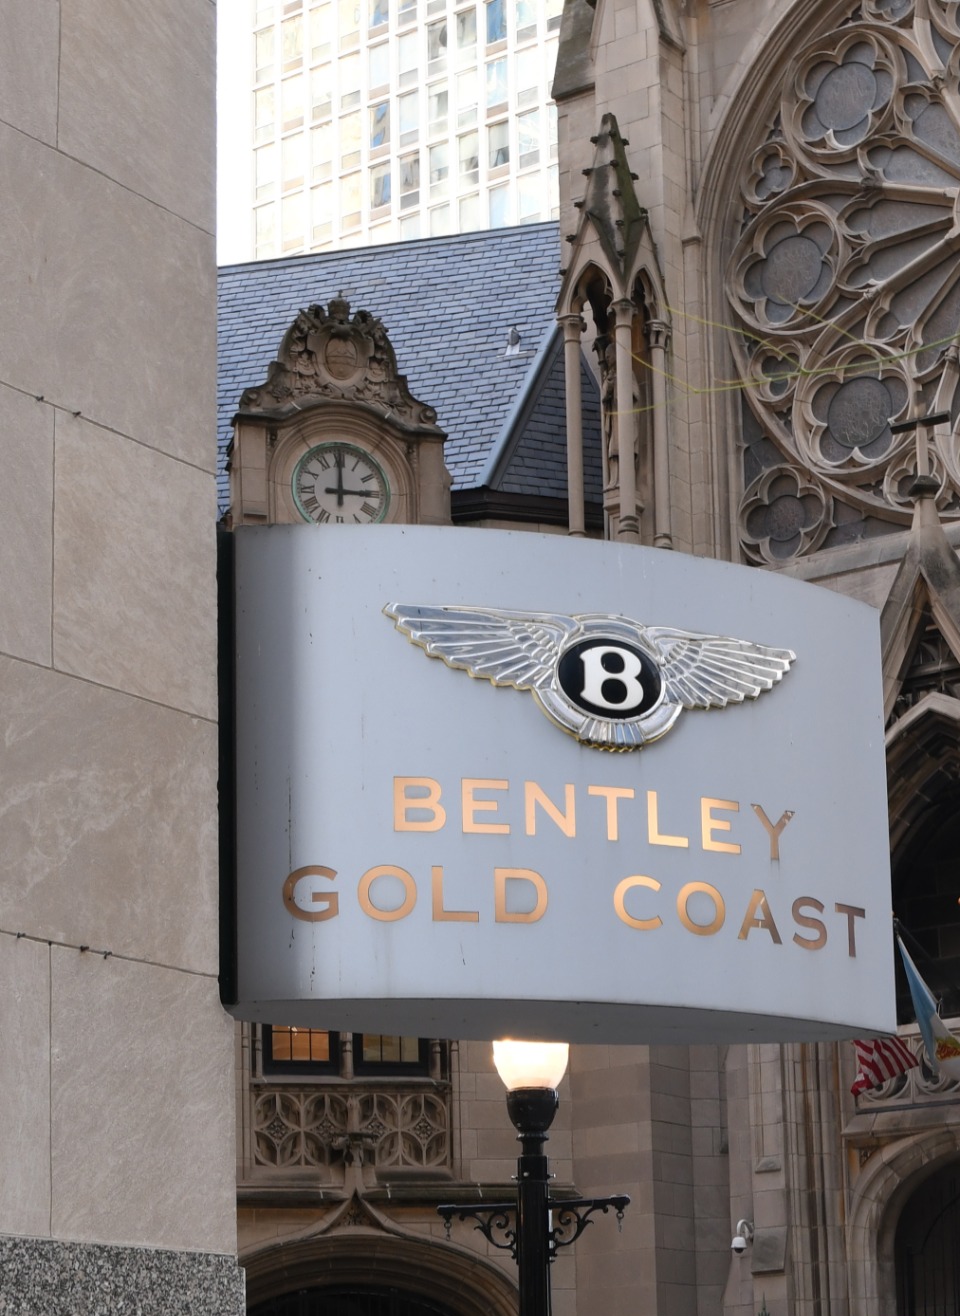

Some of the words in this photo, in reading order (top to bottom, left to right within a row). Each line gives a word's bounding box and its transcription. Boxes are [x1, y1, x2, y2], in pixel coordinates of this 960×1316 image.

[579, 644, 645, 712] B
[392, 775, 797, 862] BENTLEY
[281, 865, 550, 924] GOLD
[612, 874, 867, 960] COAST
